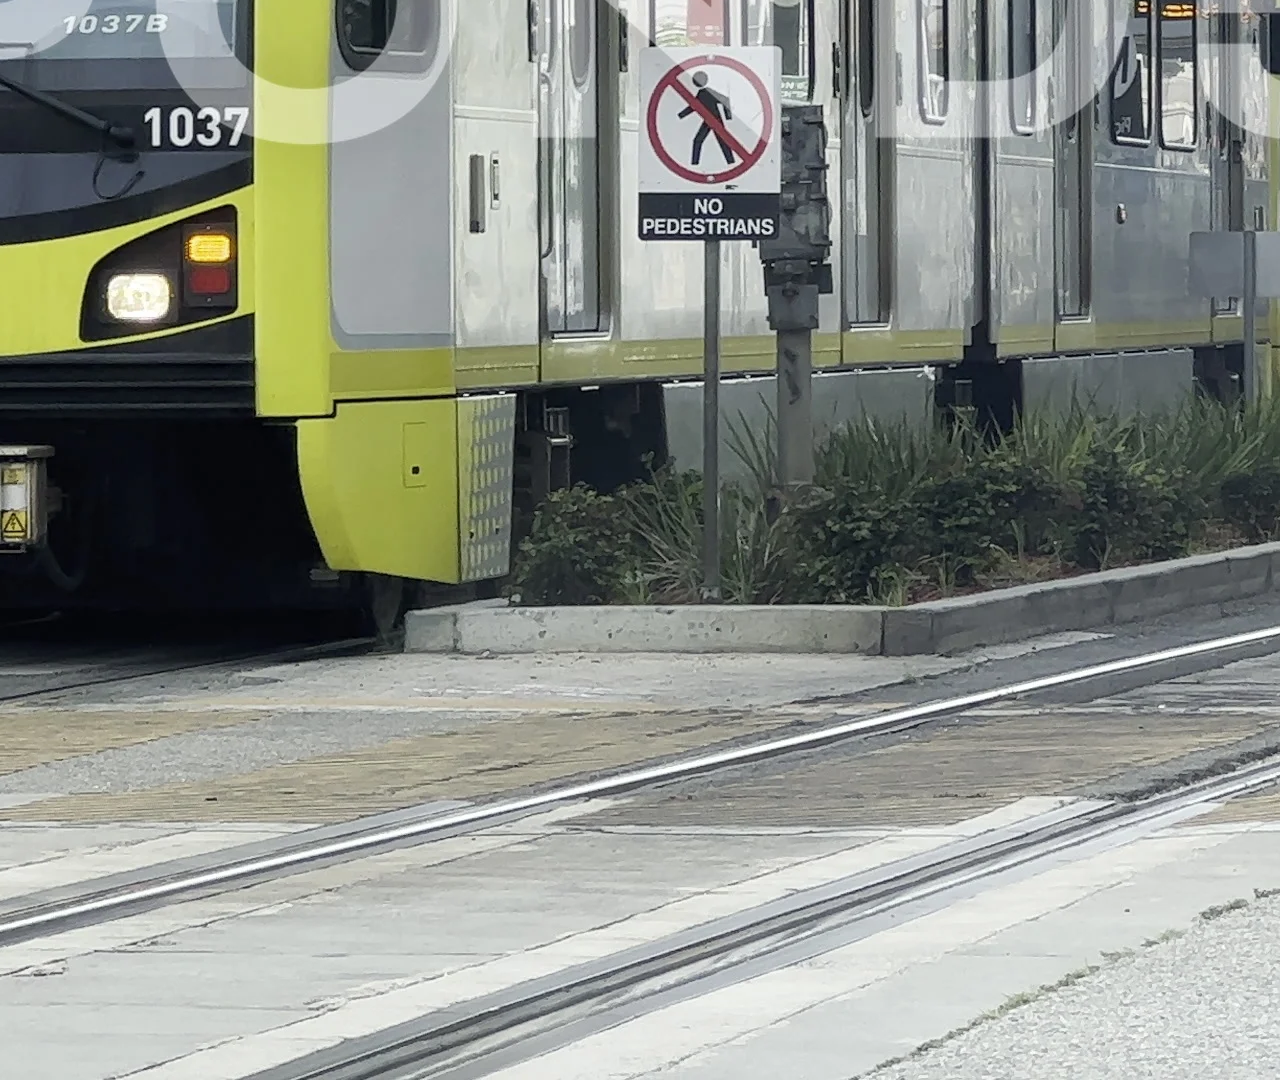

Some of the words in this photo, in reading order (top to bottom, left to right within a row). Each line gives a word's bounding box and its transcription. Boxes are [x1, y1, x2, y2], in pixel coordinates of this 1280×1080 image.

[63, 14, 169, 35] 1037B
[144, 106, 250, 147] 1037
[694, 198, 724, 215] NO
[642, 218, 775, 236] PEDESTRIANS
